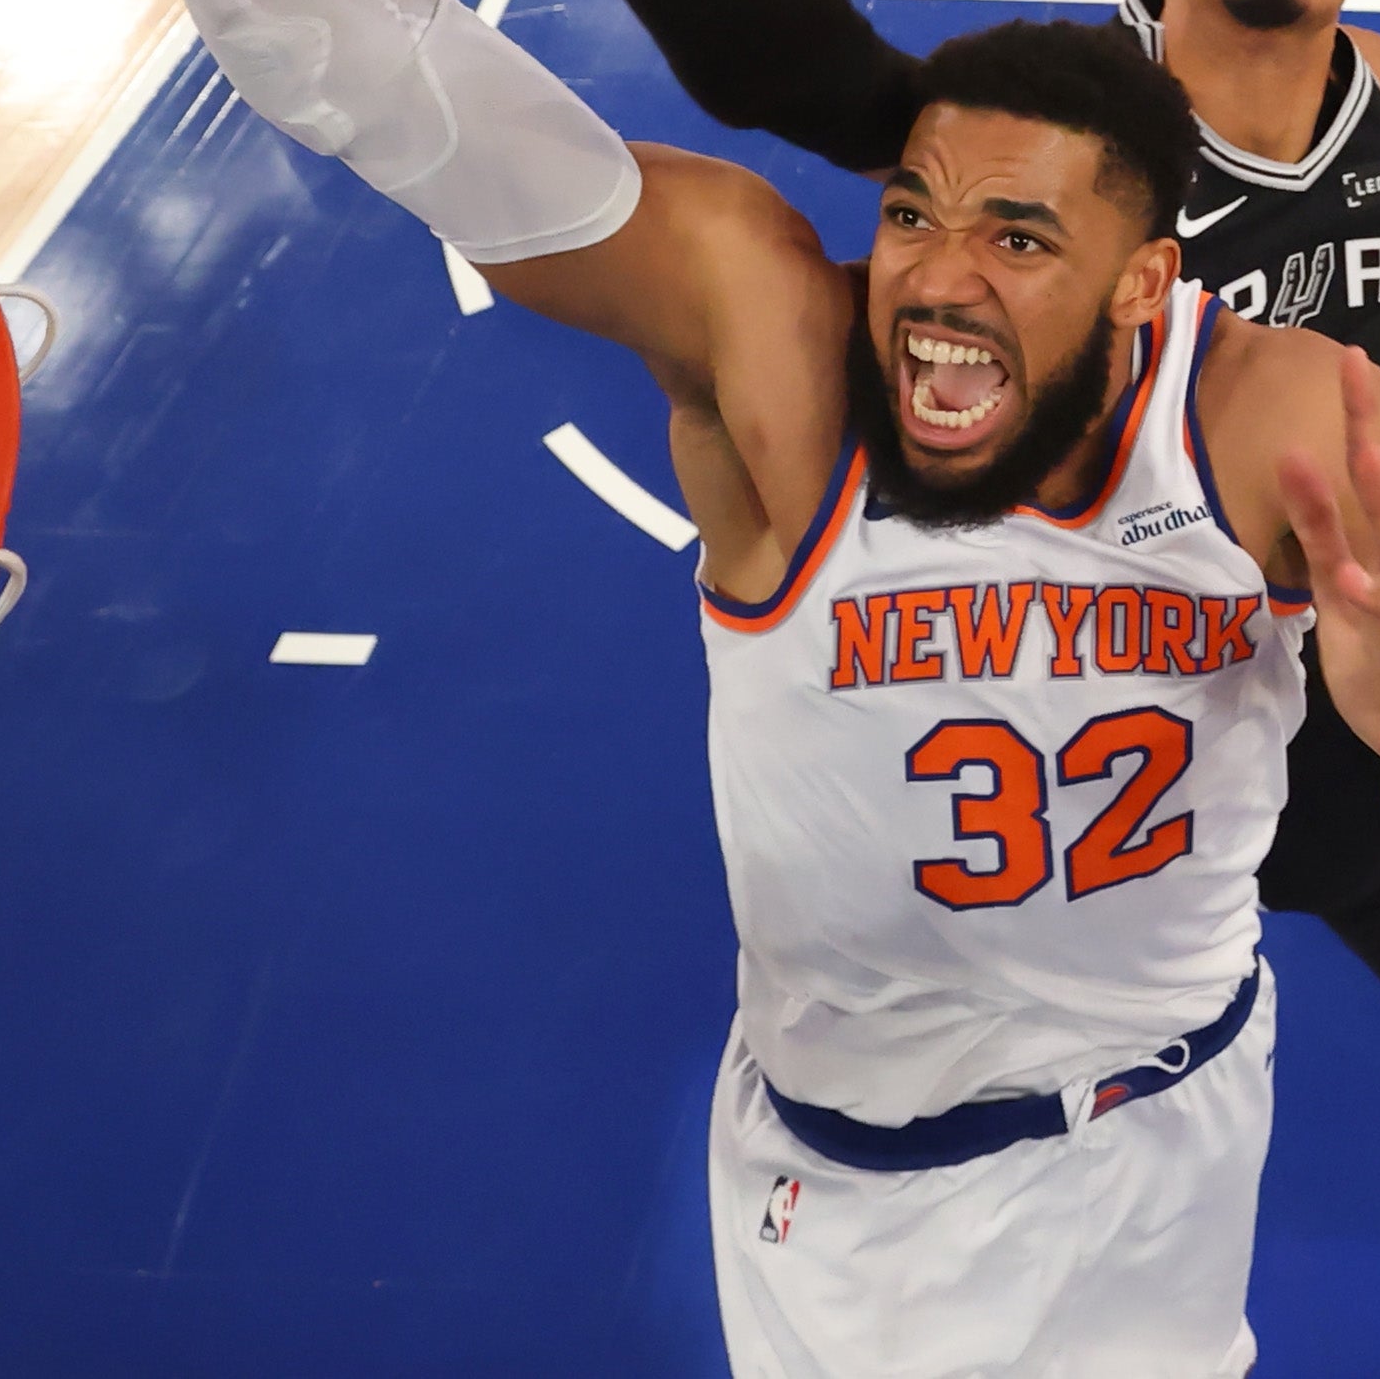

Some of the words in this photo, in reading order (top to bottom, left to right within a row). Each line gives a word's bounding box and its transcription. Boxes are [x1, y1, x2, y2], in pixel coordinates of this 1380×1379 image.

[1121, 521, 1163, 546] abu
[829, 581, 1037, 693] NEW
[1039, 580, 1264, 683] YORK
[904, 704, 1195, 912] 32
